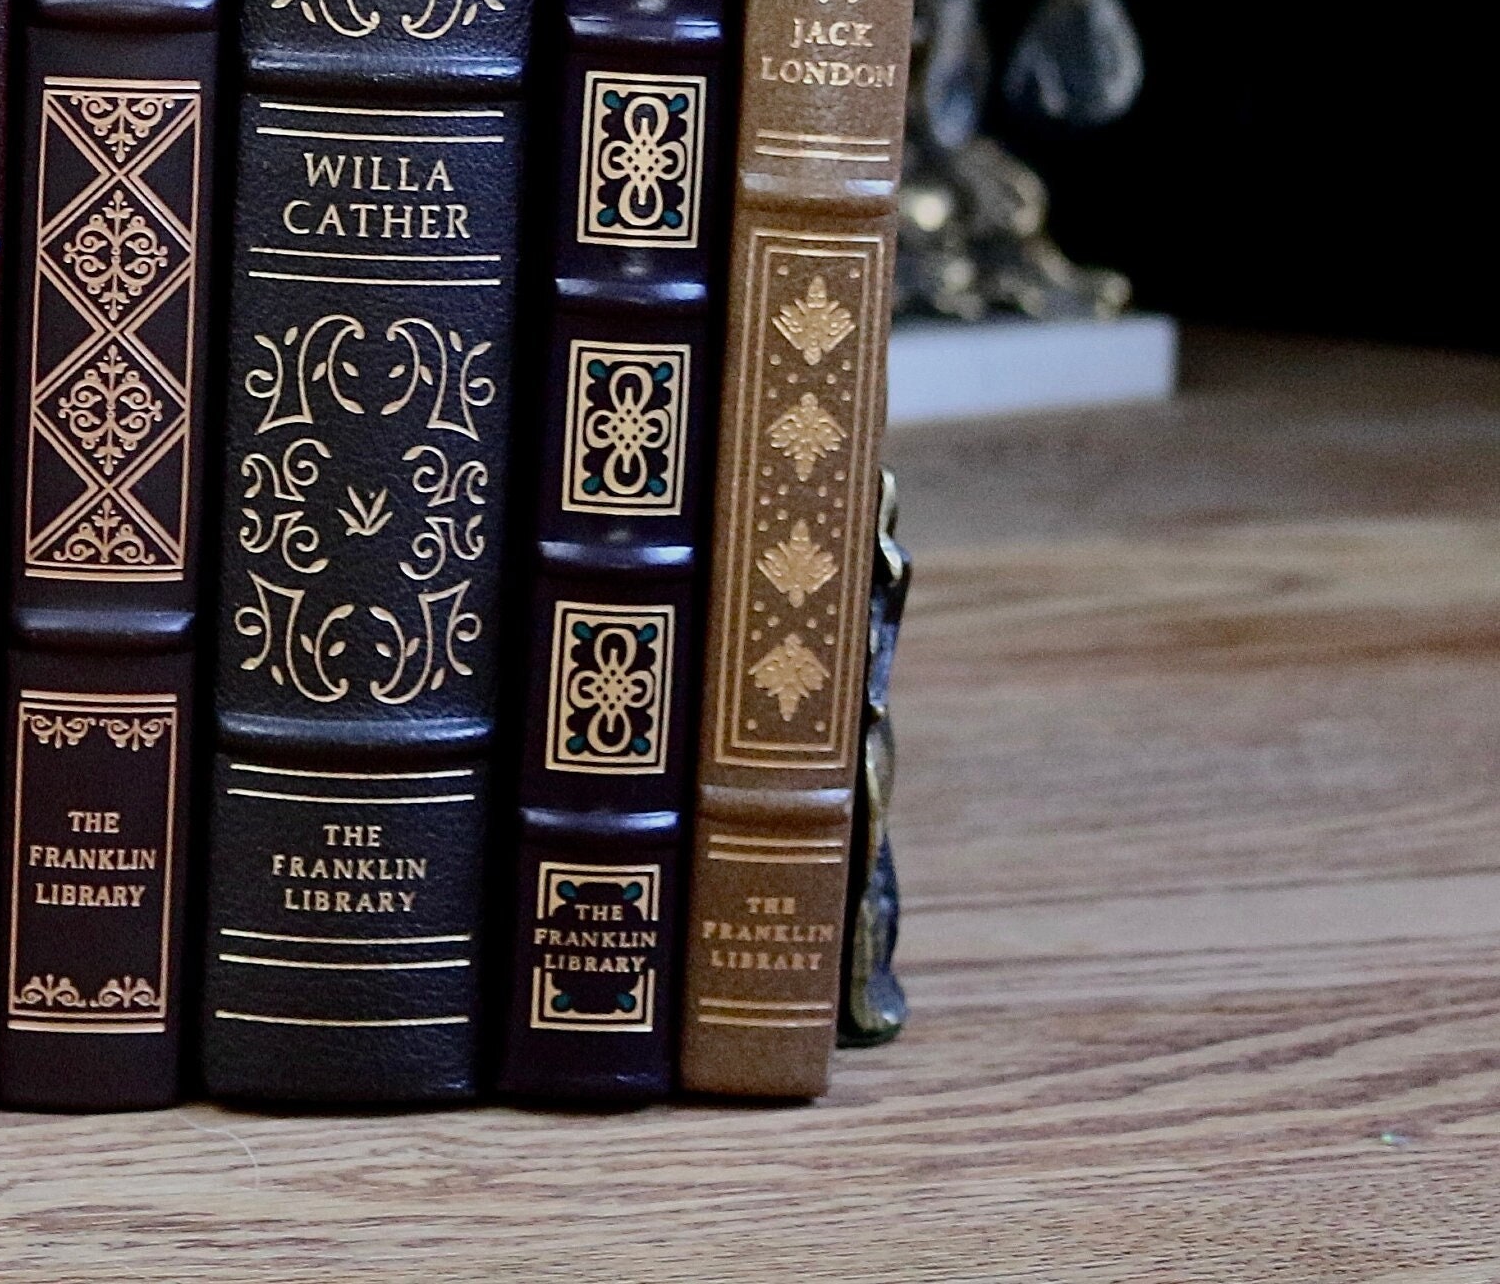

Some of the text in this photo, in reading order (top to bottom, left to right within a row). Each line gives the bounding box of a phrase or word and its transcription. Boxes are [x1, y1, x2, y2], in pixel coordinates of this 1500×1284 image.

[790, 18, 874, 48] JACK
[761, 57, 897, 88] LONDON
[303, 153, 455, 192] WILLA
[282, 201, 471, 240] CATHER
[68, 811, 119, 834] THE
[324, 825, 383, 849] THE
[29, 845, 157, 870] FRANKLIN
[272, 855, 427, 881] FRANKLIN
[36, 883, 146, 907] LIBRARY
[284, 888, 418, 913] LIBRARY
[747, 896, 795, 916] THE
[575, 903, 623, 921] THE
[534, 928, 656, 949] FRANKLIN
[702, 921, 834, 943] FRANKLIN
[544, 954, 647, 974] LIBRARY
[711, 949, 823, 971] LIBRARY
